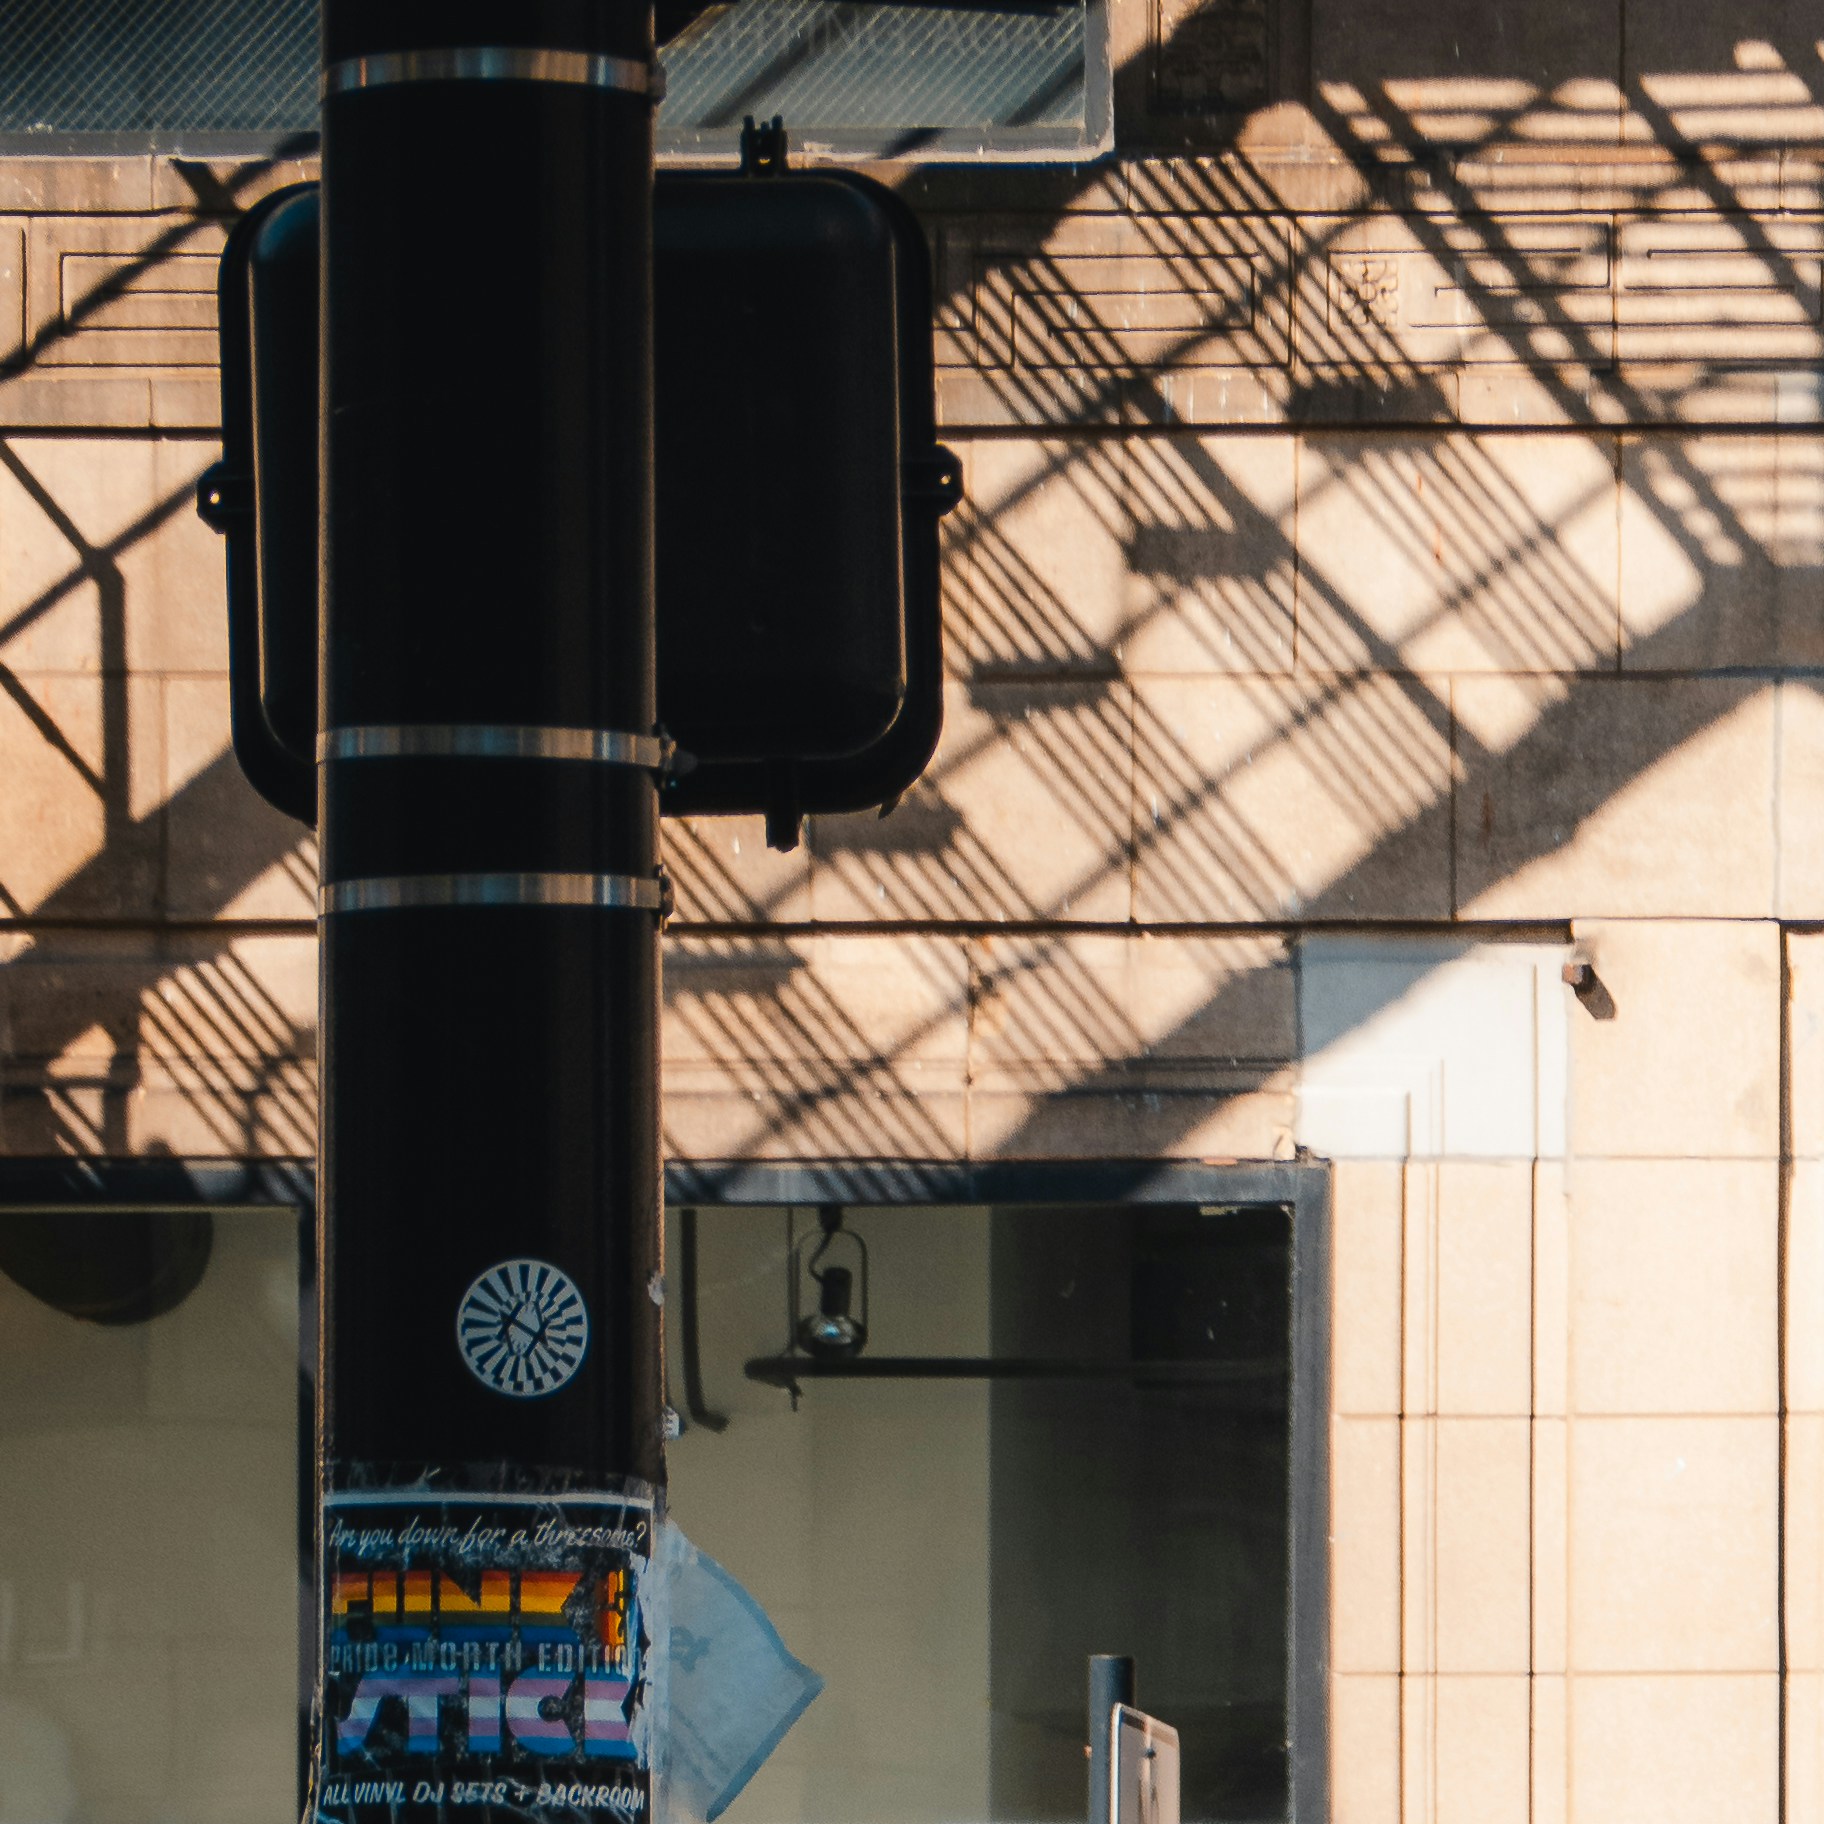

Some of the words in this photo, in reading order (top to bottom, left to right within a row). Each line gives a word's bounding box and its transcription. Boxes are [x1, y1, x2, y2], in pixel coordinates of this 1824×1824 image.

[357, 1528, 393, 1557] you
[396, 1514, 458, 1547] down
[459, 1515, 507, 1554] for
[509, 1528, 529, 1547] a
[411, 1641, 523, 1673] MONTH
[324, 1783, 348, 1806] ALL
[353, 1781, 405, 1804] VINYL
[412, 1781, 444, 1803] DJ
[451, 1781, 507, 1804] SETS
[514, 1785, 531, 1801] +
[536, 1782, 645, 1811] BACKROOM
